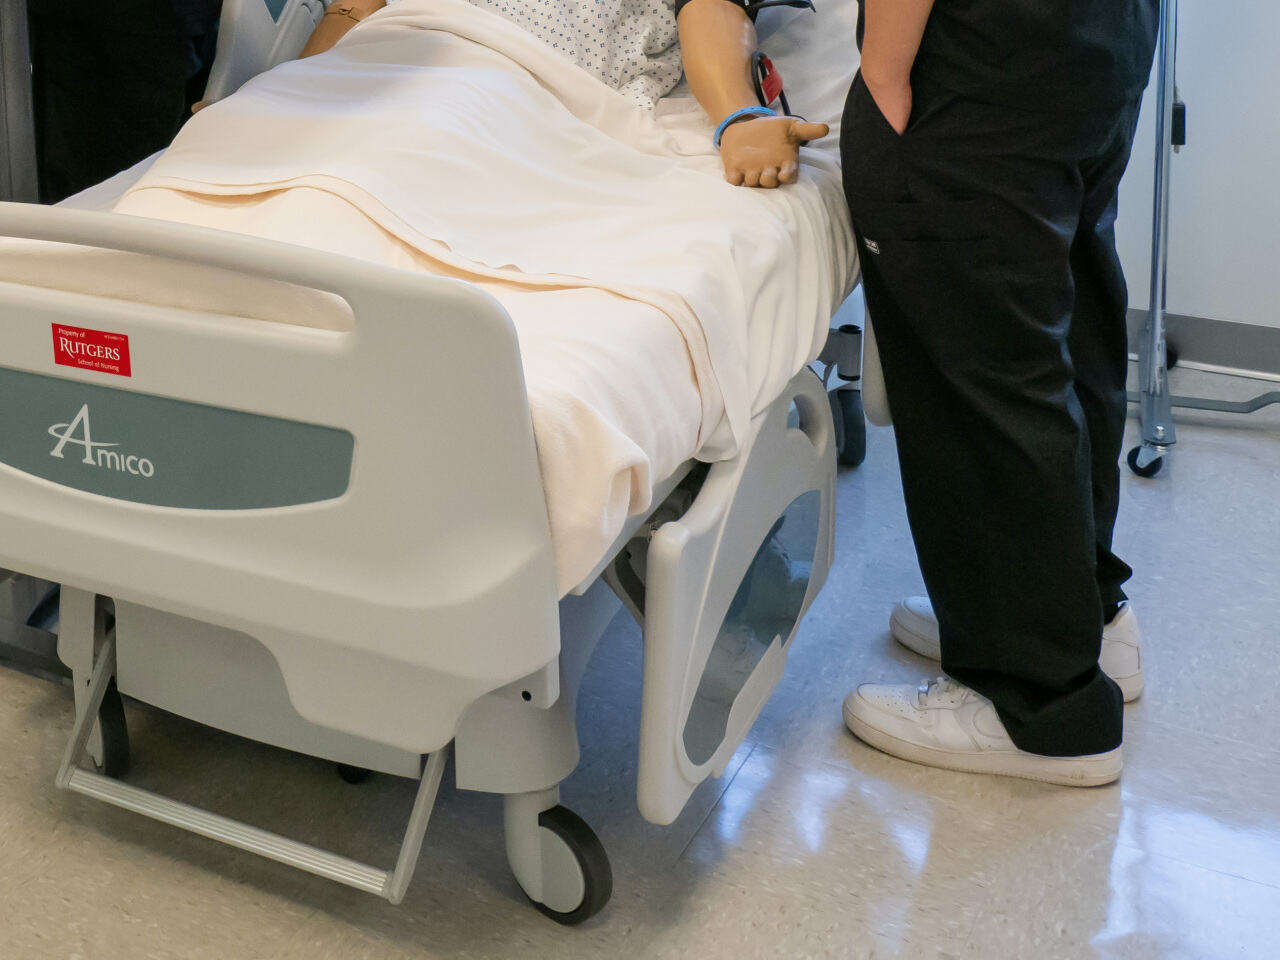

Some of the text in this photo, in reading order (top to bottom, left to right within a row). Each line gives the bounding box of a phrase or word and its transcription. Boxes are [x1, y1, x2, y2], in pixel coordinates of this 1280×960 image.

[58, 328, 79, 338] Property
[59, 337, 120, 360] RUTGERS
[77, 358, 94, 367] School
[100, 362, 120, 373] Nursing
